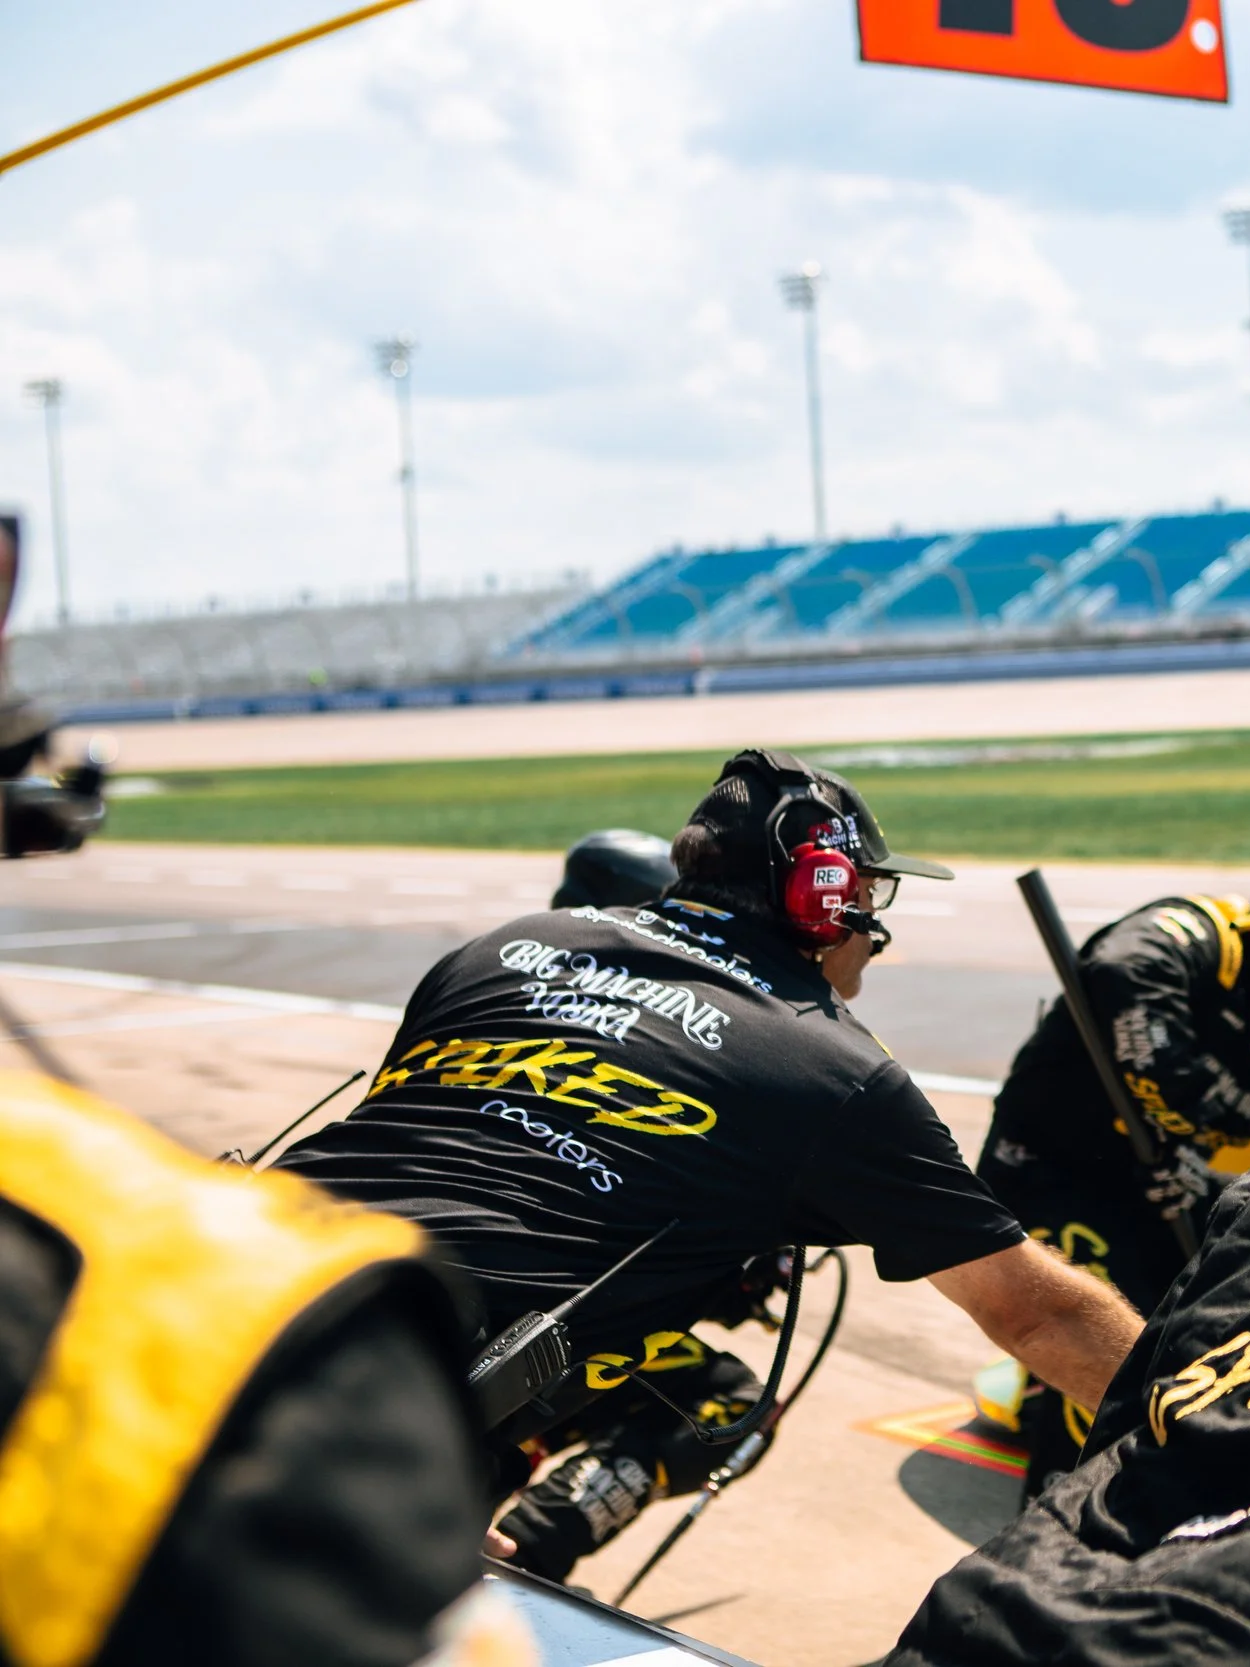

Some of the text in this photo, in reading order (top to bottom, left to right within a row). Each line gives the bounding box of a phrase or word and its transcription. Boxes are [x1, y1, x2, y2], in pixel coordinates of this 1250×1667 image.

[832, 815, 857, 834] BG
[500, 939, 731, 1051] BIG MACHINE
[520, 981, 641, 1046] VODKA
[480, 1100, 623, 1192] coolers
